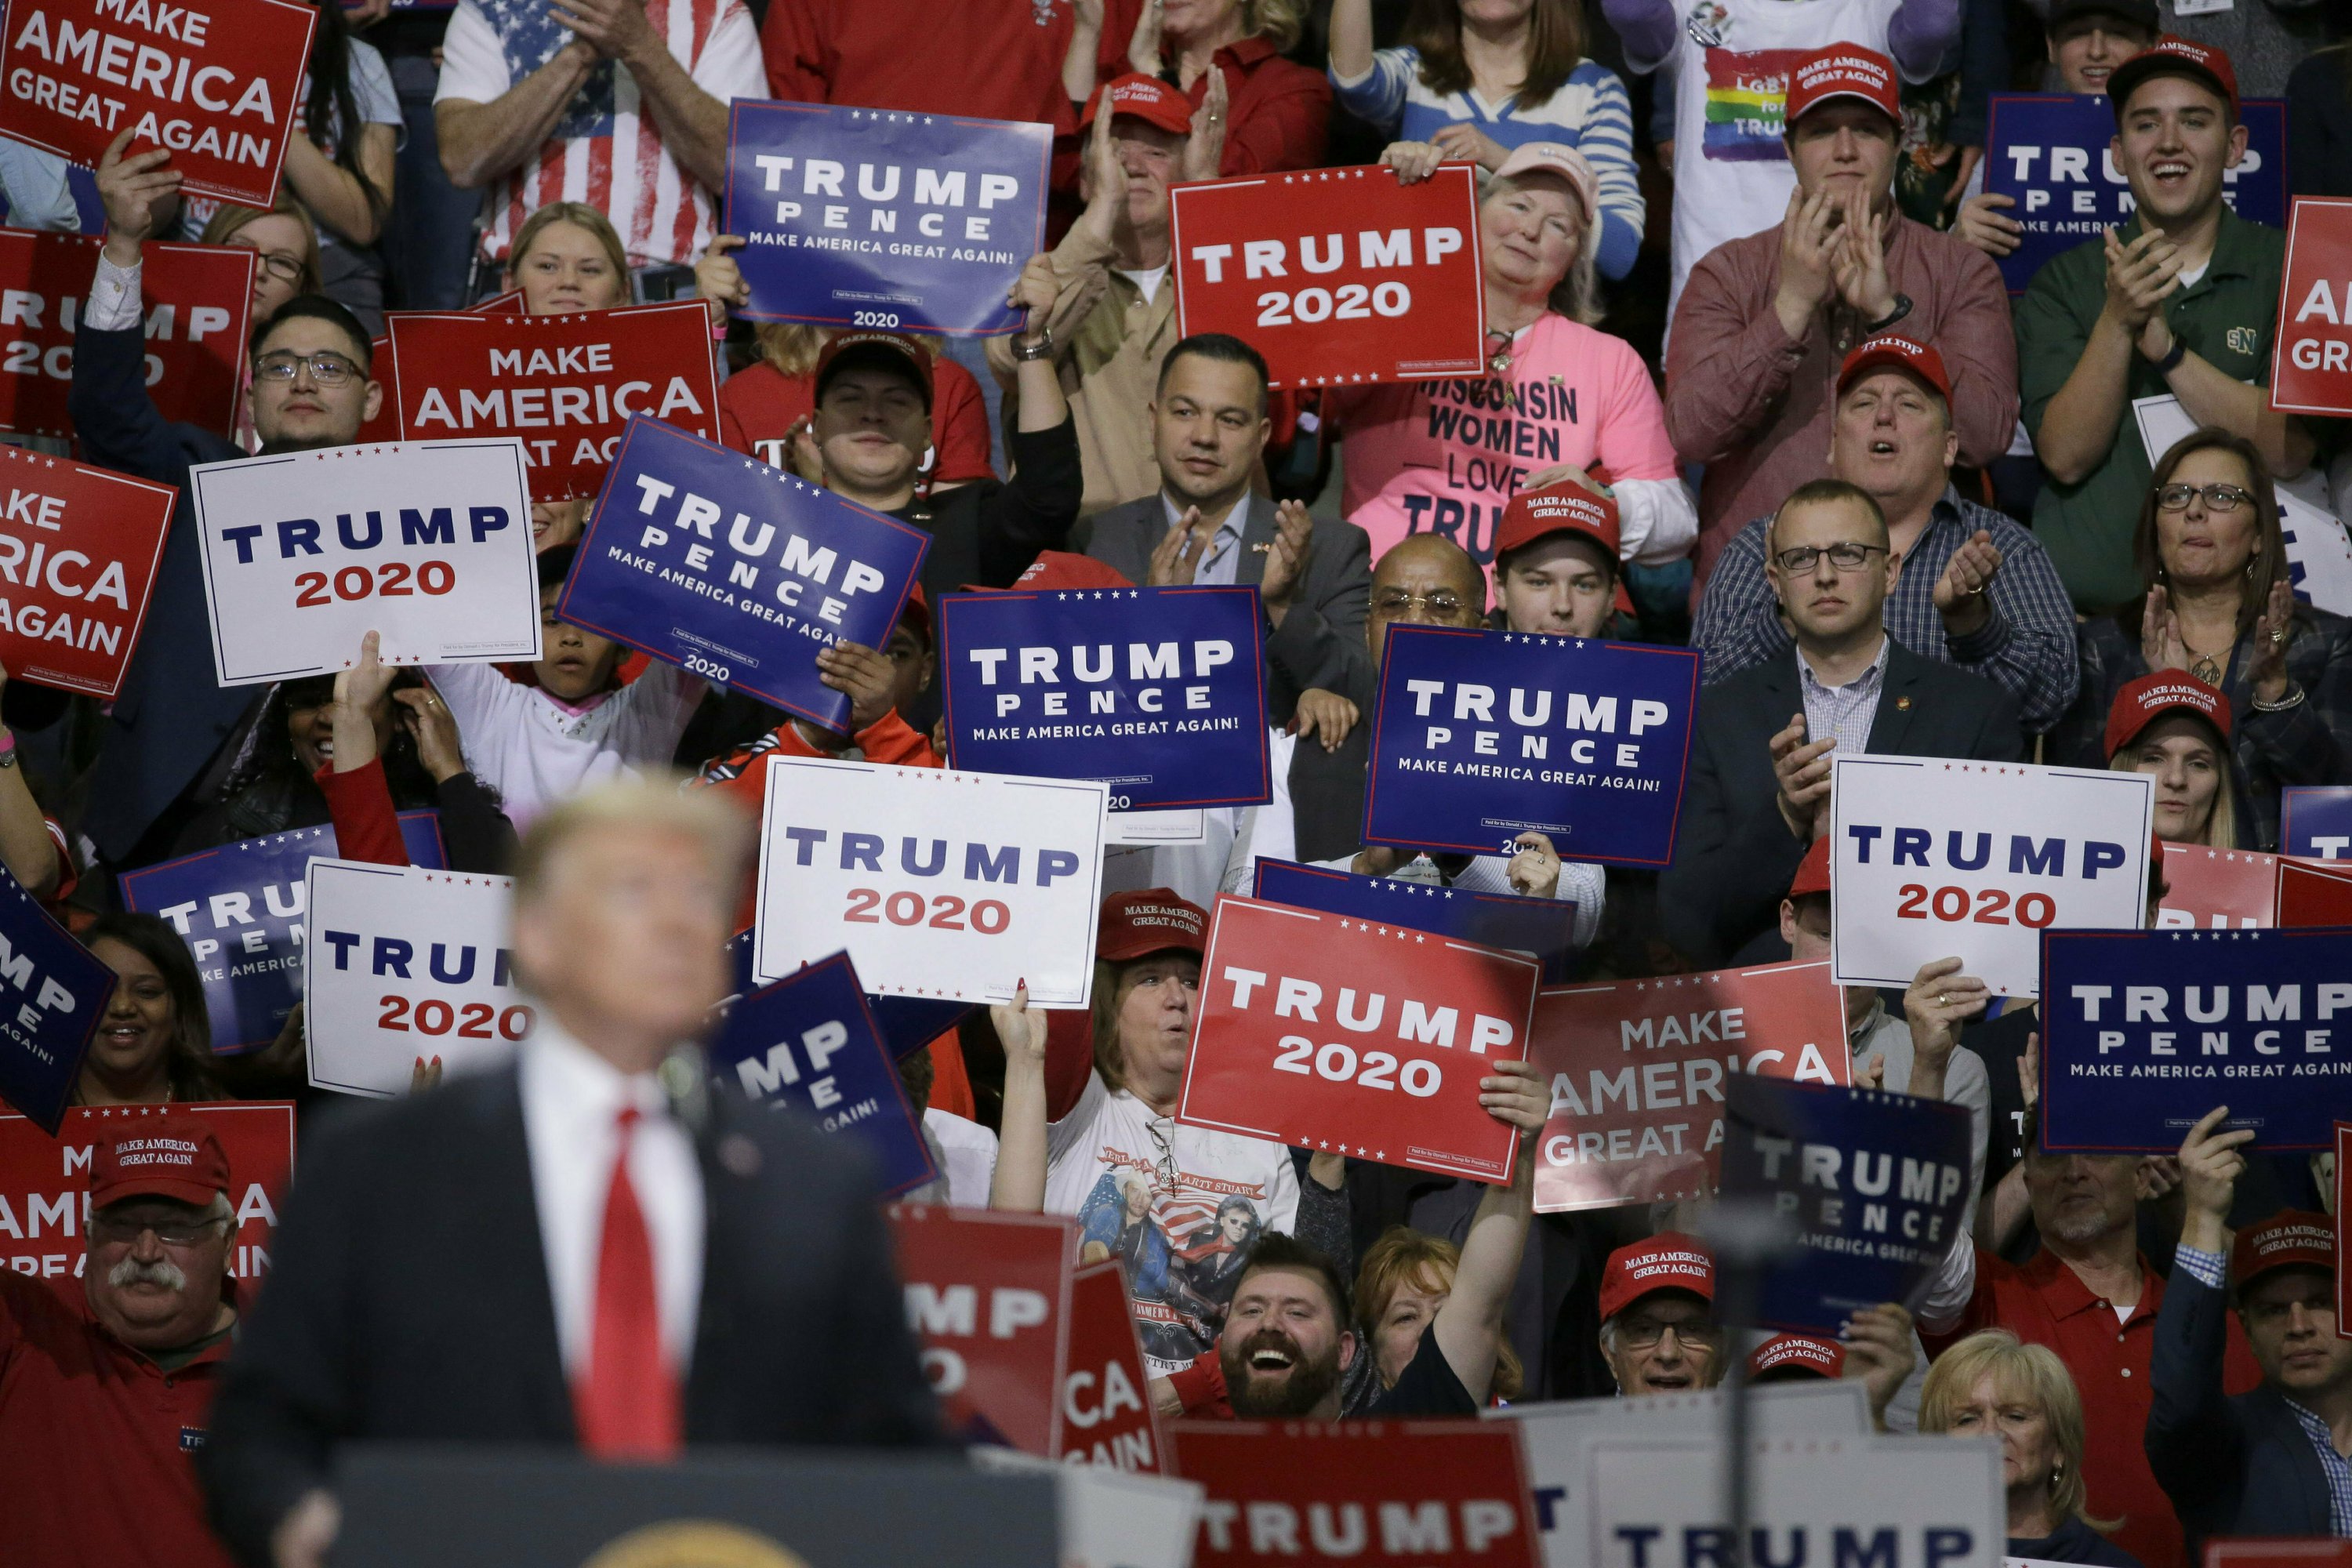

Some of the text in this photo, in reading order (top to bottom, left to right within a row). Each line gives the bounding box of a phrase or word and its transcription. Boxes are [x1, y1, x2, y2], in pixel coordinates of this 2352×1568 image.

[93, 0, 211, 47] MAKE
[14, 11, 275, 125] AMERICA
[1796, 56, 1889, 81] MAKE AMERICA
[1802, 70, 1883, 91] GREAT AGAIN
[10, 67, 271, 168] GREAT AGAIN
[1733, 118, 1787, 136] TRU
[755, 154, 1019, 210] TRUMP
[2007, 146, 2263, 184] TRP
[776, 201, 991, 241] PENCE
[2026, 189, 2238, 213] PENE
[750, 231, 1014, 265] MAKE AMERICA GREAT AGAIN!
[1192, 227, 1464, 284] TRUMP
[854, 310, 899, 328] 2020
[1257, 281, 1412, 328] 2020
[2, 340, 165, 387] 200
[489, 343, 614, 376] MAKE
[1861, 337, 1923, 355] Trump
[414, 376, 704, 429] AMERICA
[1428, 405, 1560, 462] WOMEN
[1448, 452, 1530, 499] LOVE
[1526, 496, 1606, 519] MAKE AMERICA
[1534, 507, 1601, 527] GREAT AGAIN
[222, 506, 510, 564] TRUMP
[635, 473, 885, 597] TRUMP
[1403, 495, 1501, 565] TRU
[0, 533, 129, 611] RICA
[294, 560, 456, 608] 2020
[608, 546, 657, 574] MAKE
[659, 567, 735, 607] AMERICA
[740, 599, 796, 629] GREAT
[640, 525, 848, 626] PENCE
[684, 654, 730, 681] 2020
[969, 640, 1235, 685] TRUMP
[996, 686, 1211, 717] PENCE
[1406, 679, 1669, 735] TRUMP
[2138, 684, 2217, 706] MAKE AMERICA
[2144, 695, 2212, 713] GREAT AGAIN
[974, 717, 1240, 741] MAKE AMERICA GREAT AGAIN!
[1426, 726, 1640, 768] PENCE
[1399, 757, 1661, 793] MAKE AMERICA GREAT AGAIN!
[786, 826, 1080, 887] TRUMP
[1849, 825, 2126, 880] TRUMP
[158, 880, 305, 935] TRU
[843, 887, 1011, 935] 2020
[1124, 906, 1203, 927] MAKE AMERICA
[1133, 916, 1199, 935] GREAT AGAIN
[1897, 883, 2056, 929] 2020
[193, 923, 304, 963] PEN
[325, 929, 517, 987] TRU
[230, 955, 304, 978] AMERIC
[378, 994, 537, 1042] 2020
[1224, 965, 1515, 1054] TRUMP
[2071, 983, 2352, 1023] TRUMP
[0, 1022, 54, 1065] AGAIN!
[1621, 1007, 1746, 1052] MAKE
[2099, 1029, 2332, 1055] PENCE
[1272, 1034, 1443, 1098] 2020
[2071, 1062, 2352, 1077] MAKE AMERICA GREAT AGAIN
[115, 1138, 198, 1154] MAKE AMERICA
[119, 1153, 192, 1167] GREAT AGAIN
[1544, 1123, 1690, 1167] GREAT
[1215, 1182, 1255, 1196] STUART
[1753, 1137, 1962, 1207] TRUMP
[1774, 1190, 1944, 1243] PENCE
[2252, 1225, 2335, 1247] MAKE AMERICA
[1624, 1251, 1711, 1270] MAKE AMERICA
[2259, 1238, 2332, 1256] GREAT AGAIN
[1634, 1264, 1707, 1279] GREAT AGAIN
[1756, 1339, 1836, 1364] MAKE AMERICA
[1762, 1349, 1830, 1369] GREAT AGAIN
[1198, 1498, 1518, 1555] TRUMP
[1614, 1525, 1975, 1568] TRUMP
